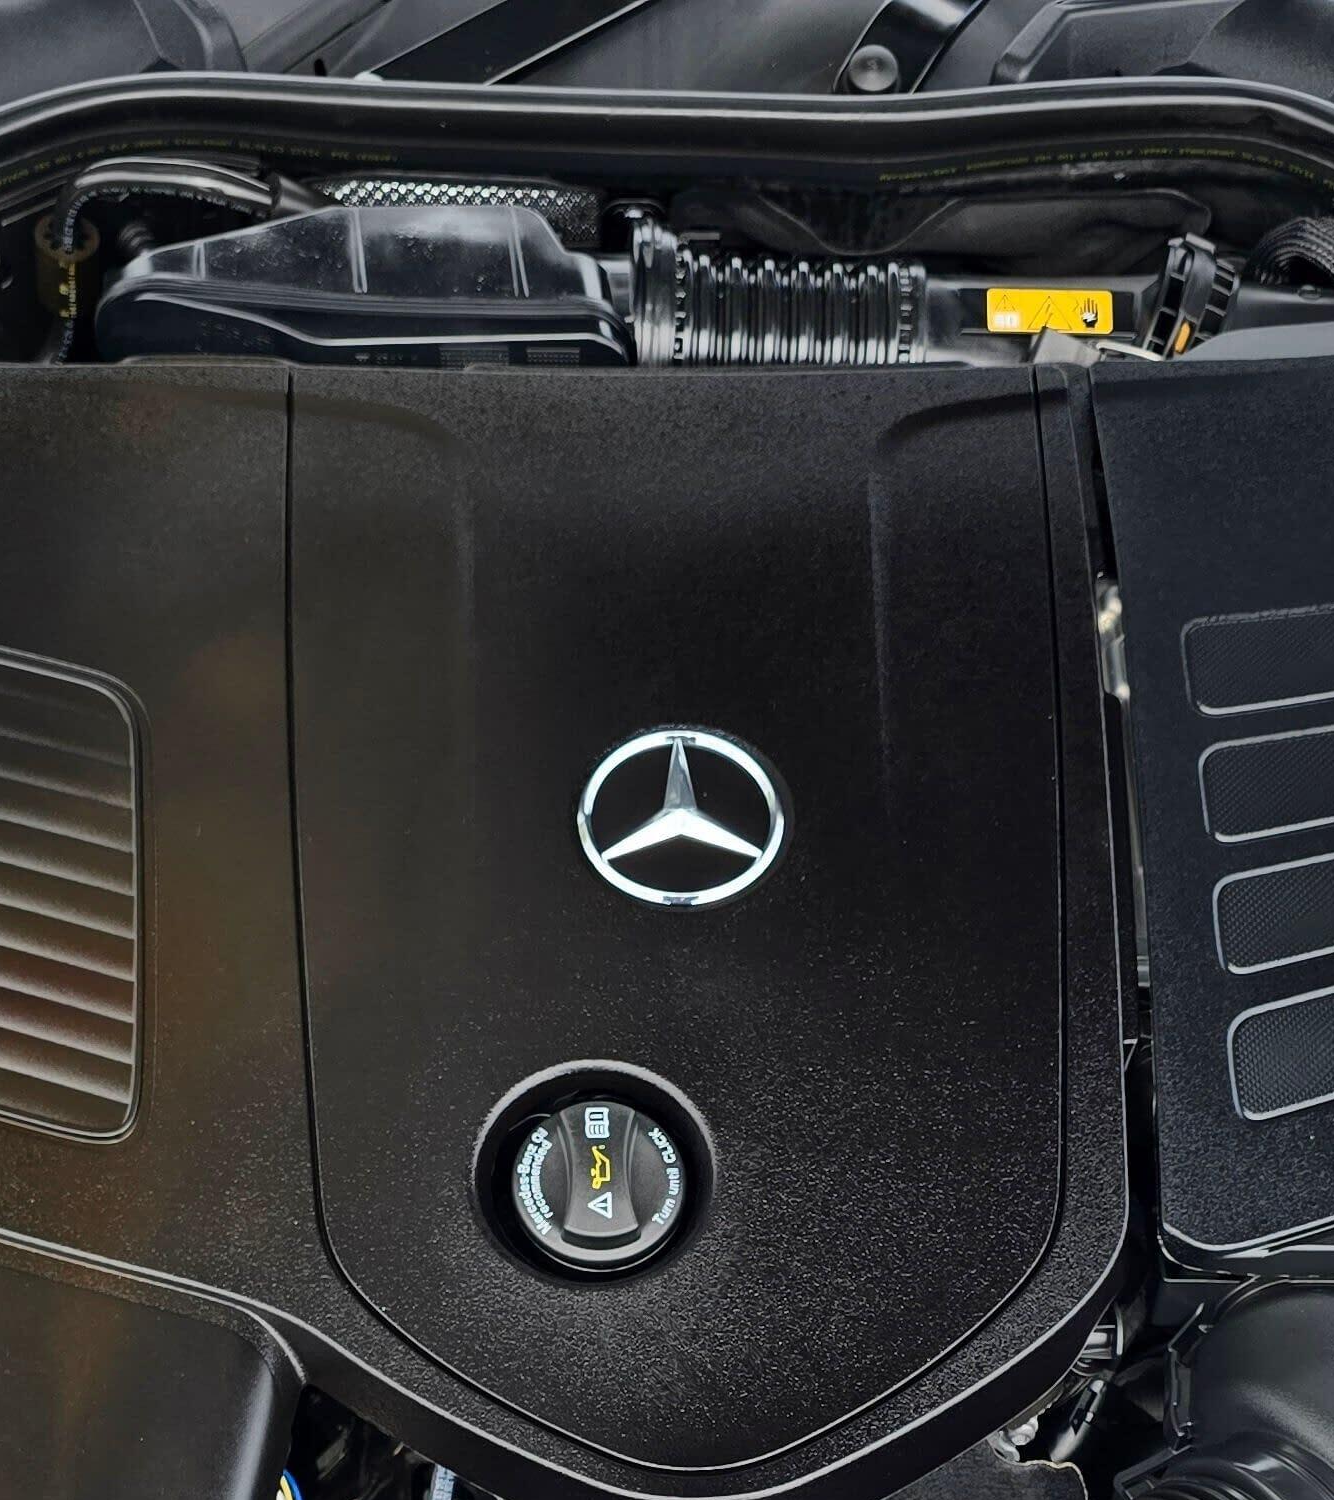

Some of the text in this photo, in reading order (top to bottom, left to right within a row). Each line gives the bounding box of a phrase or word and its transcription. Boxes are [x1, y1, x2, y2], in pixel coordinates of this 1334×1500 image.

[517, 1143, 552, 1236] Mercedes-Benz
[531, 1139, 554, 1219] recommended
[648, 1127, 681, 1225] Turn until CLICK
